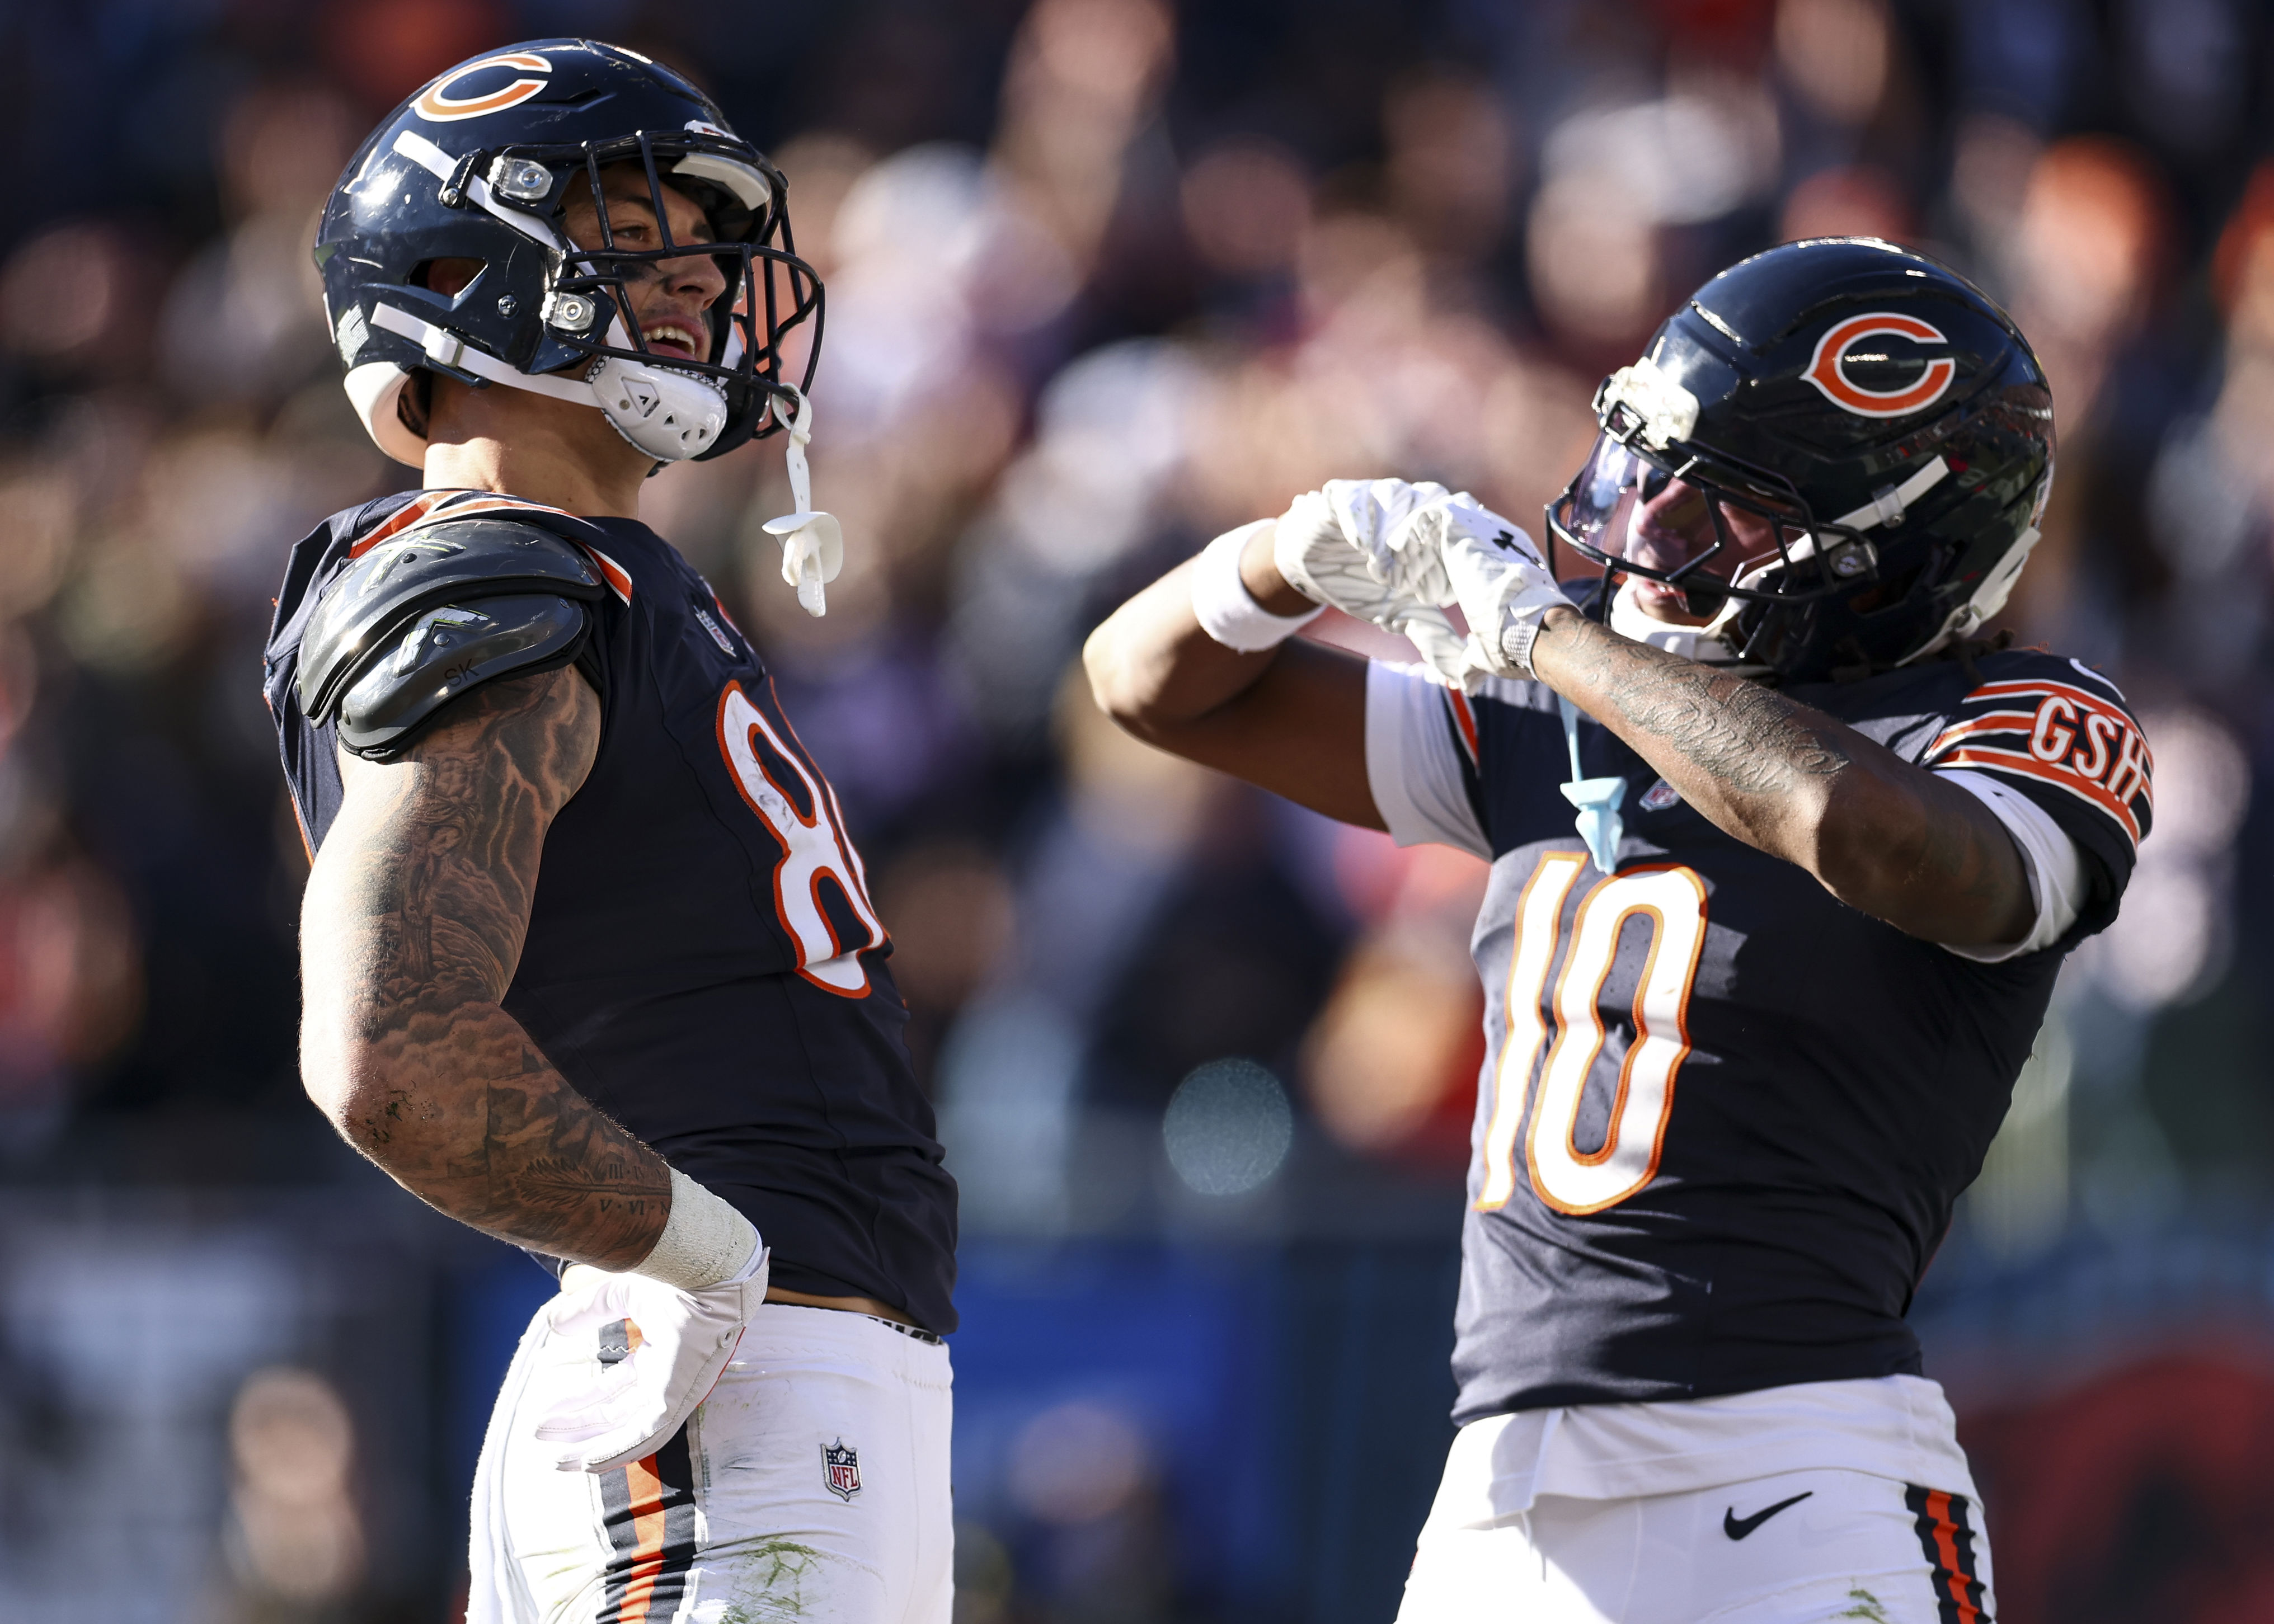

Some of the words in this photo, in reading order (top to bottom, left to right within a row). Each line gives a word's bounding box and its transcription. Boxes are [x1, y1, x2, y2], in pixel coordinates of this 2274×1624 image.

[409, 54, 553, 122] C
[1799, 312, 1956, 418] C
[444, 658, 480, 688] SK
[2027, 694, 2144, 807] GSH
[1472, 850, 1708, 1215] 10
[831, 1465, 858, 1490] NFL
